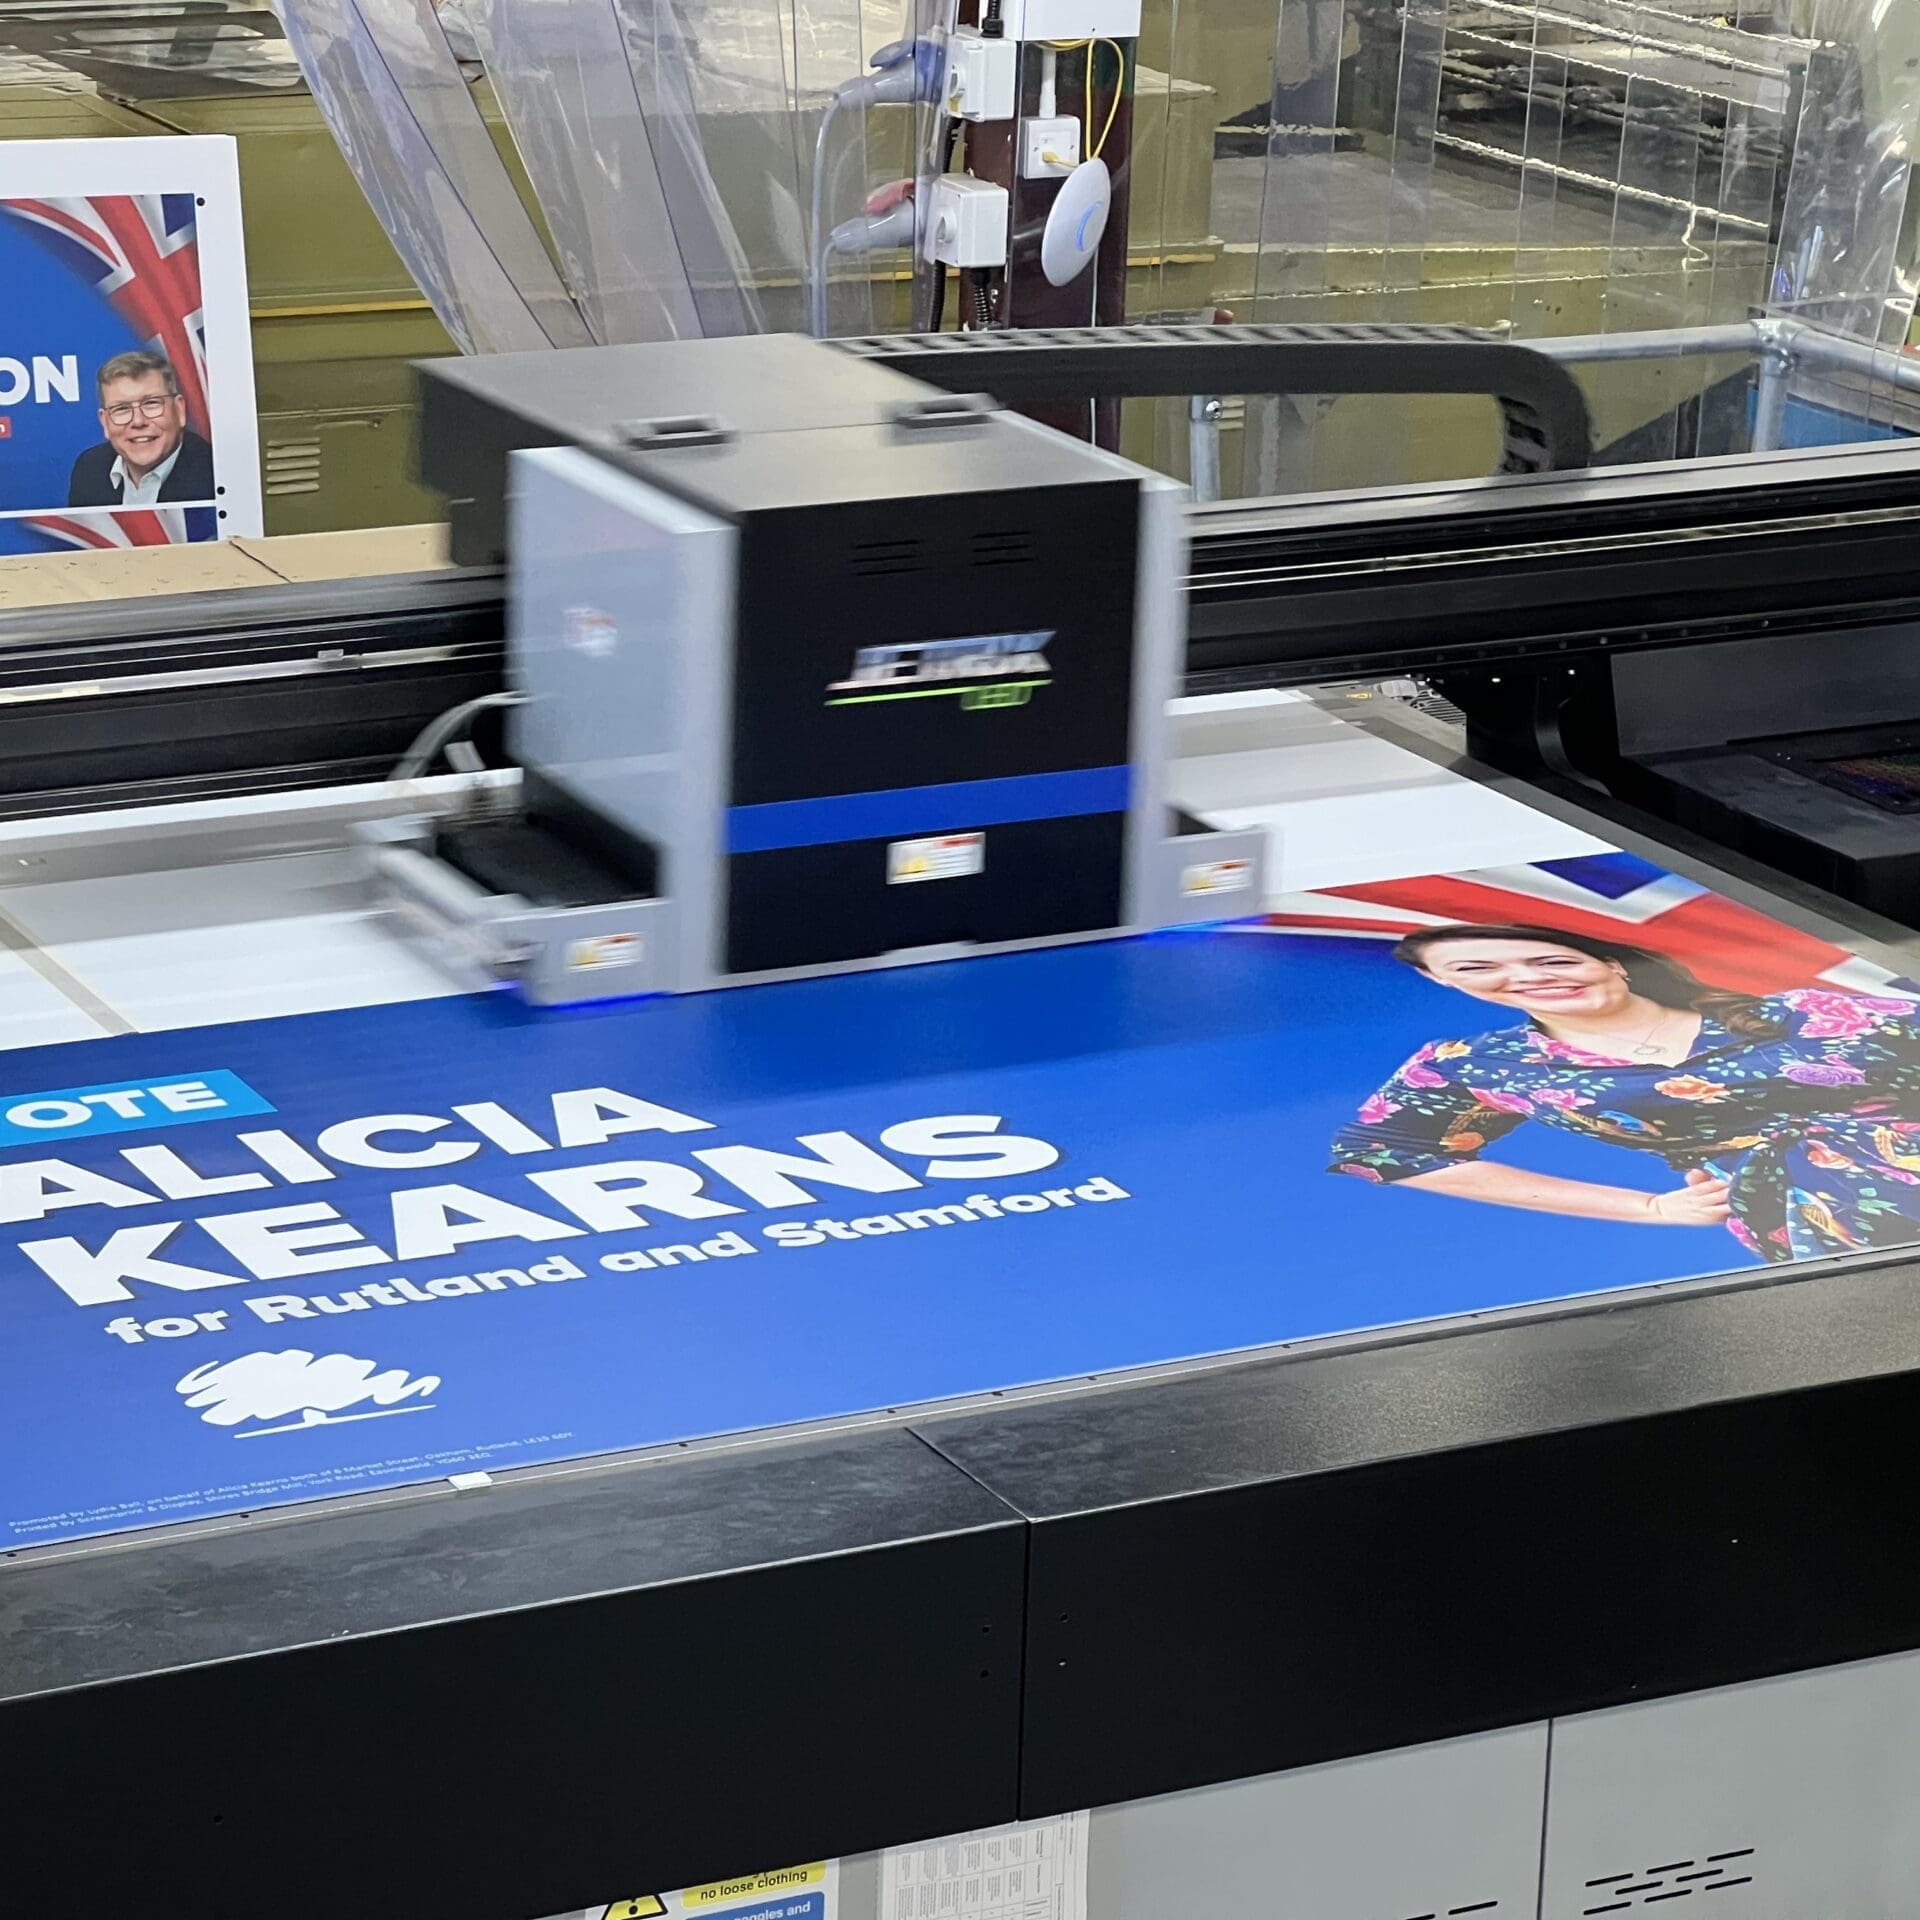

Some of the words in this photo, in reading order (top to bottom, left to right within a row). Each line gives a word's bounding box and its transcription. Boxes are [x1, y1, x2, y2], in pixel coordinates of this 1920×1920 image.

[0, 1087, 718, 1224] ALICIA
[17, 1115, 1060, 1306] KEARNS
[104, 1307, 229, 1344] for
[242, 1256, 588, 1324] Rutland
[599, 1231, 759, 1272] and
[762, 1177, 1132, 1248] Stamford
[8, 1512, 67, 1527] Promoted
[69, 1510, 84, 1519] by
[163, 1490, 200, 1502] behalf
[218, 1482, 248, 1493] Alicia
[249, 1477, 289, 1488] Kearns
[343, 1461, 383, 1473] Market
[14, 1522, 57, 1535] Printed
[59, 1519, 75, 1528] by
[241, 1486, 279, 1498] Bridge
[701, 1889, 717, 1900] no
[720, 1881, 754, 1896] loose
[757, 1870, 808, 1890] clothing
[786, 1900, 811, 1917] and
